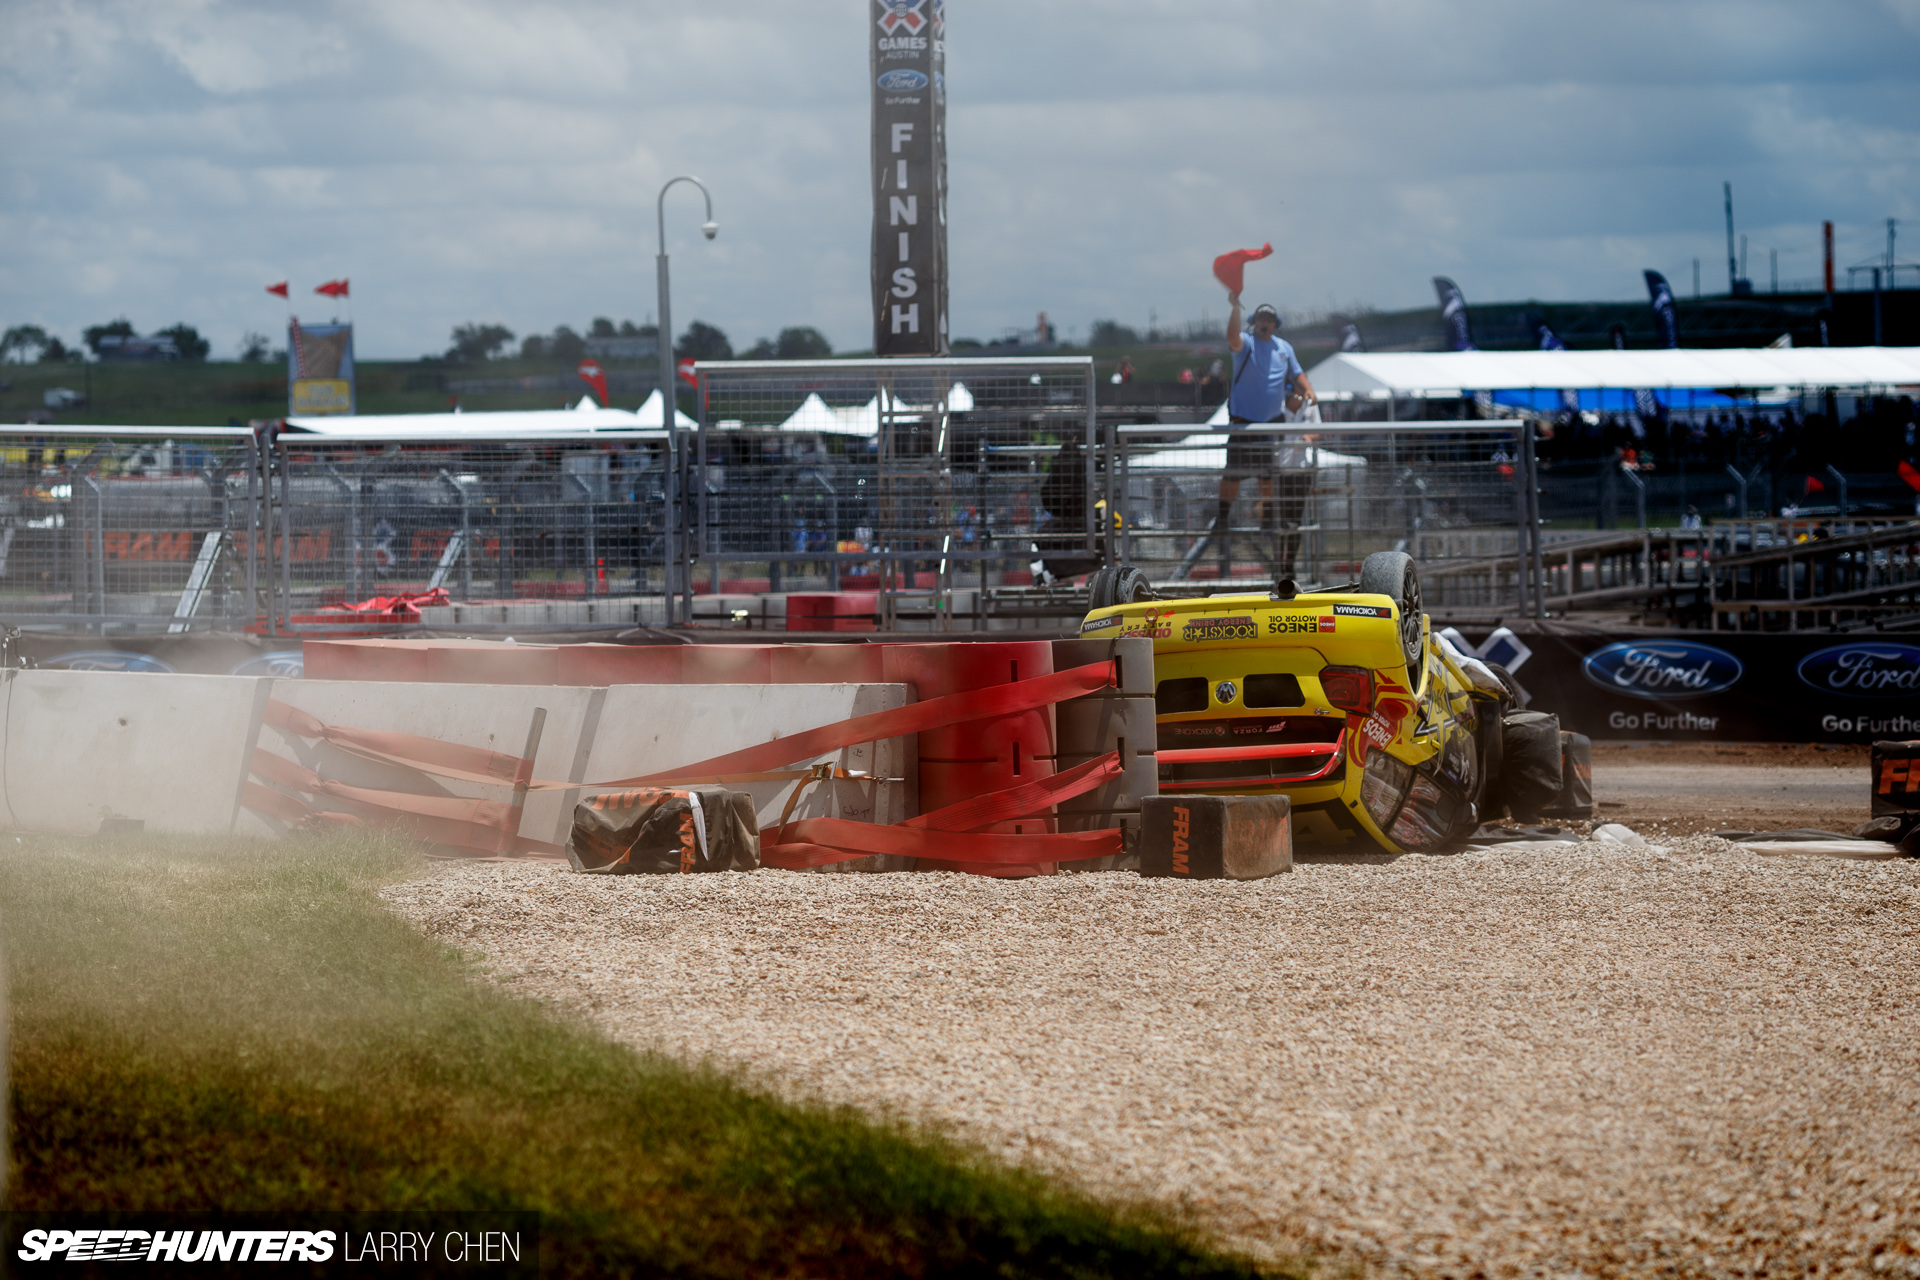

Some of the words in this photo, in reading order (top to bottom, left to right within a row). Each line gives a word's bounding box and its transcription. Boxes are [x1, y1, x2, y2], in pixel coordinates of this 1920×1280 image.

[878, 37, 928, 51] GAMES
[885, 51, 920, 60] AUSTIN
[890, 123, 919, 334] FINISH
[1336, 606, 1378, 616] YOKOHAMA
[1084, 618, 1112, 631] YOKOHAMA
[1190, 619, 1215, 628] DRINK
[1218, 617, 1251, 626] ENERGY
[1268, 615, 1283, 623] OIL
[1285, 615, 1317, 623] MOTOR
[1119, 621, 1172, 632] BATTERY
[1268, 623, 1318, 634] ENEOS
[1614, 649, 1713, 689] Ford
[1609, 712, 1639, 730] Go
[1643, 712, 1720, 731] Further
[1821, 714, 1853, 733] Go
[1233, 727, 1263, 735] FORZA
[1363, 718, 1392, 748] ENEOS
[1172, 806, 1190, 874] FRAM
